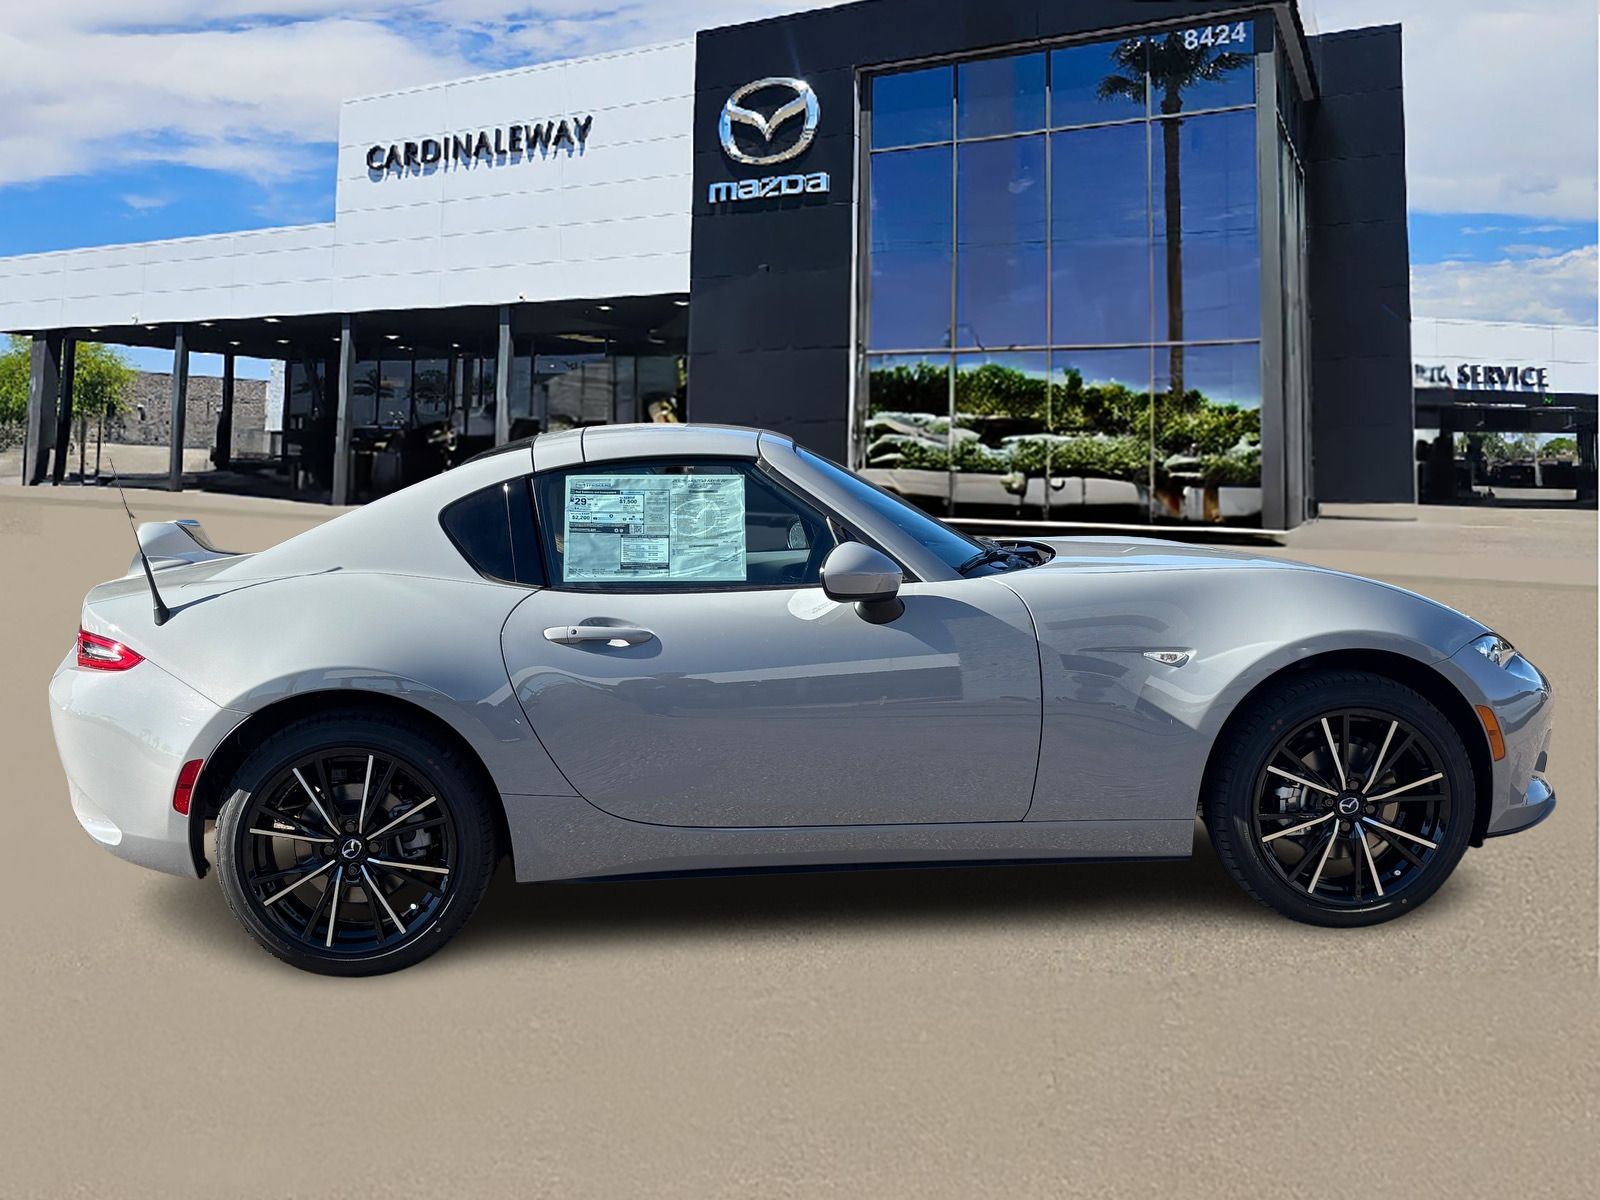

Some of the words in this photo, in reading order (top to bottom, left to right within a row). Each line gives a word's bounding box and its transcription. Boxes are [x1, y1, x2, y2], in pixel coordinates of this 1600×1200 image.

[1184, 22, 1246, 49] 8424
[366, 115, 593, 170] CARDINALEWAY
[708, 171, 830, 203] mazda
[1457, 363, 1549, 387] SERVICE
[574, 497, 587, 506] 29
